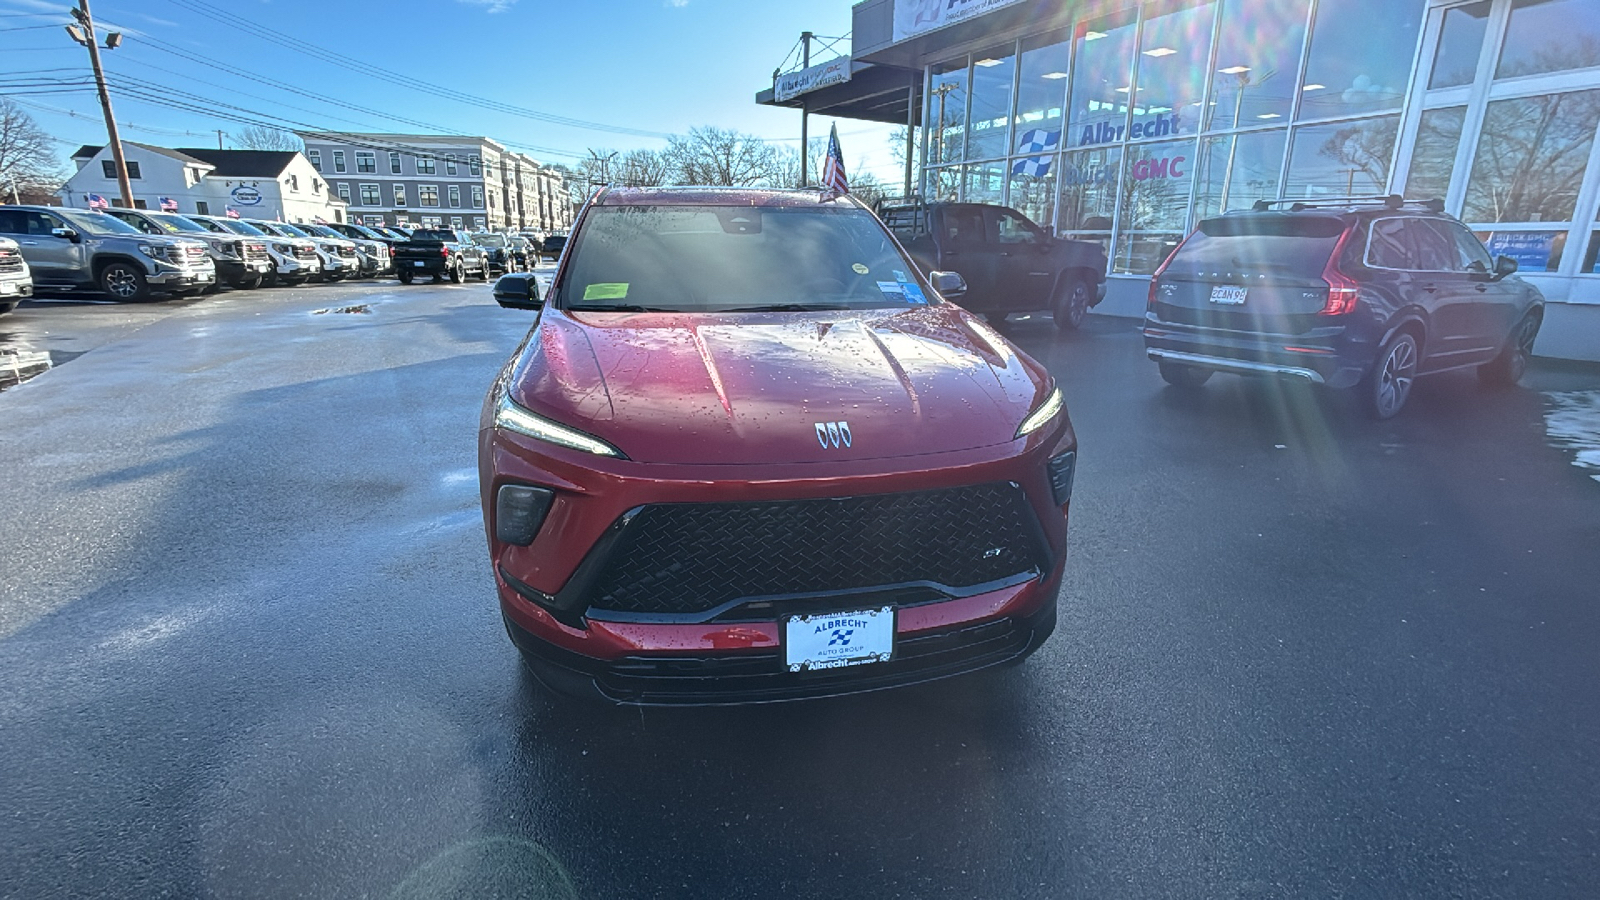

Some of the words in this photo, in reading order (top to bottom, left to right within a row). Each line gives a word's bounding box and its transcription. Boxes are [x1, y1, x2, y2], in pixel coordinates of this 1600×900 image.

[1080, 113, 1181, 146] Albrecht
[1132, 156, 1186, 181] GMC
[814, 619, 868, 635] ALBRECHT
[838, 646, 865, 654] GROUP
[808, 659, 849, 671] Albrecht
